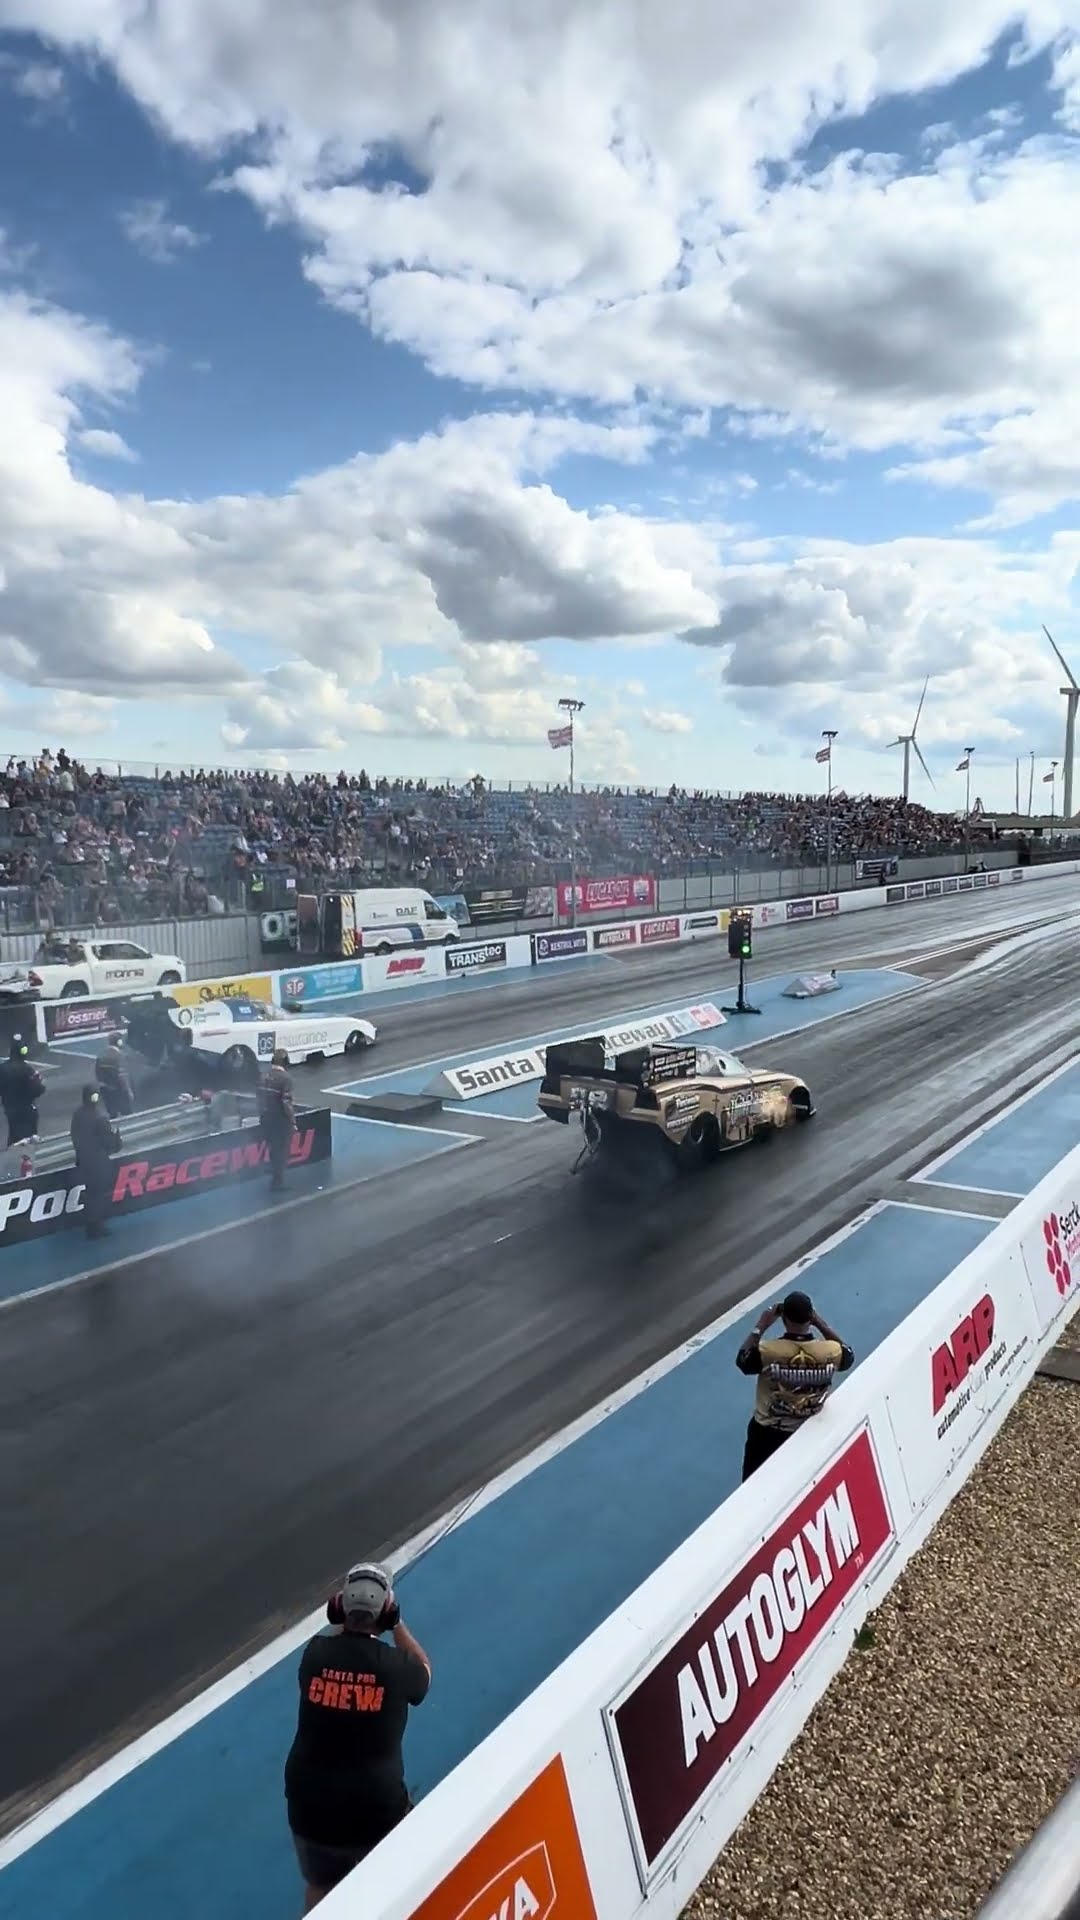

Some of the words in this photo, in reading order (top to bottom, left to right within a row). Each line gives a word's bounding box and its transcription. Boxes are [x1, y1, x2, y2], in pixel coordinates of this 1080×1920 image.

[285, 977, 304, 995] STP
[602, 1022, 671, 1050] aceway
[456, 1059, 535, 1092] Santa
[112, 1128, 315, 1202] Racewy
[932, 1293, 996, 1418] ARP
[677, 1480, 860, 1768] AUTOGLYM
[321, 1667, 354, 1683] SANTA
[308, 1676, 385, 1712] CREW
